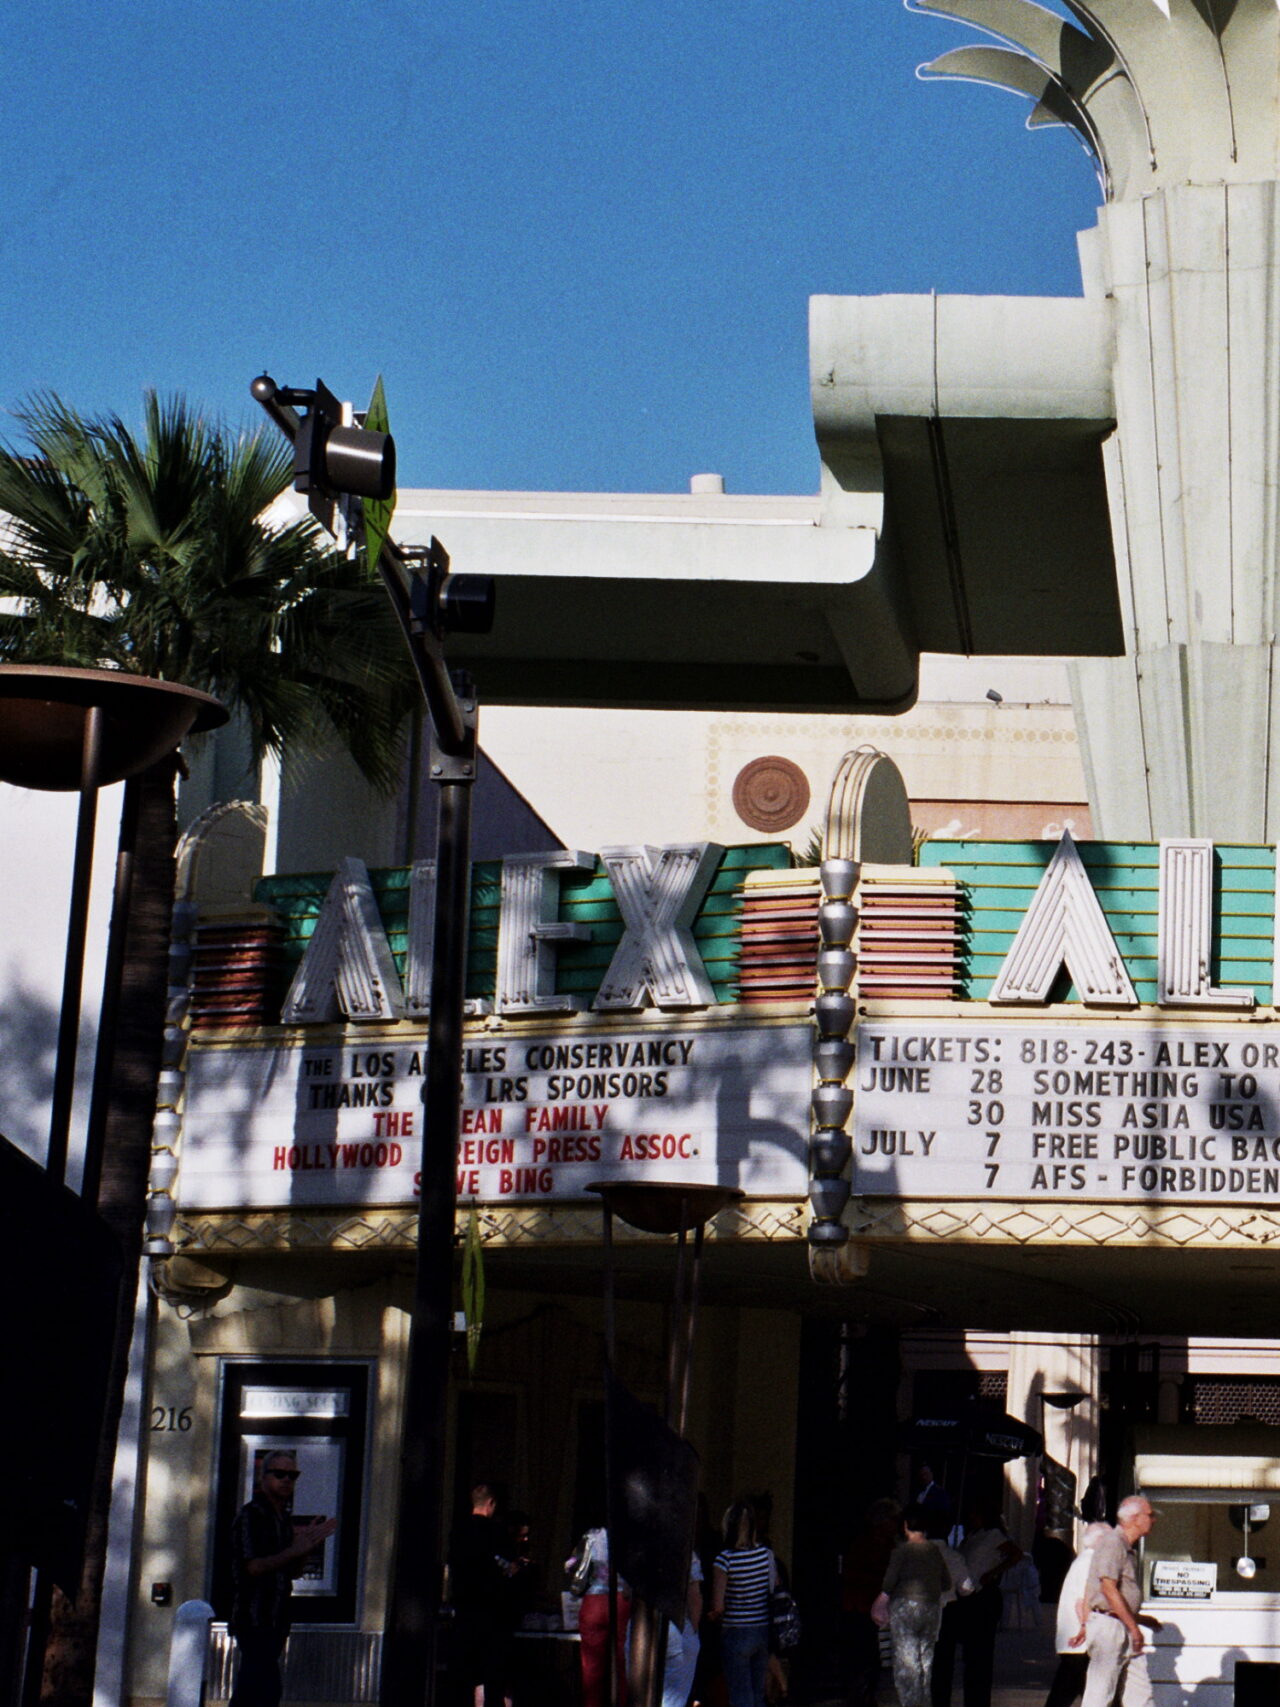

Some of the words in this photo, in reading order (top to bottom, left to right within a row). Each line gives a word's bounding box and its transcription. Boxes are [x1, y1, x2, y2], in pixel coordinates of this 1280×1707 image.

[280, 841, 725, 1023] ALEX
[304, 1059, 333, 1077] THE
[352, 1052, 394, 1078] LOS
[525, 1040, 694, 1071] CONSERVANCY
[870, 1036, 1002, 1063] TICKETS:
[1241, 1042, 1279, 1069] OR
[309, 1082, 394, 1109] THANKS
[486, 1077, 528, 1103] LRS
[548, 1072, 669, 1100] SPONSORS
[861, 1067, 931, 1093] JUNE
[970, 1069, 1003, 1094] 28
[1034, 1070, 1198, 1098] SOMETHING
[1220, 1073, 1258, 1099] TO
[373, 1112, 413, 1137] THE
[525, 1105, 609, 1132] FAMILY
[967, 1100, 1005, 1126] 30
[1032, 1102, 1101, 1128] MISS
[1122, 1103, 1190, 1129] ASIA
[1209, 1104, 1265, 1131] USA
[273, 1143, 402, 1170] HOLLYWOOD
[533, 1136, 601, 1163] PRESS
[620, 1134, 699, 1161] ASSOC.
[861, 1130, 936, 1156] JULY
[985, 1132, 1001, 1158] 7
[1032, 1133, 1098, 1160] FREE
[1113, 1134, 1217, 1161] PUBLIC
[500, 1169, 553, 1194] BING
[984, 1164, 1000, 1189] 7
[1031, 1165, 1086, 1190] AFS
[1122, 1165, 1279, 1193] FORBIDDEN
[151, 1406, 193, 1432] 216
